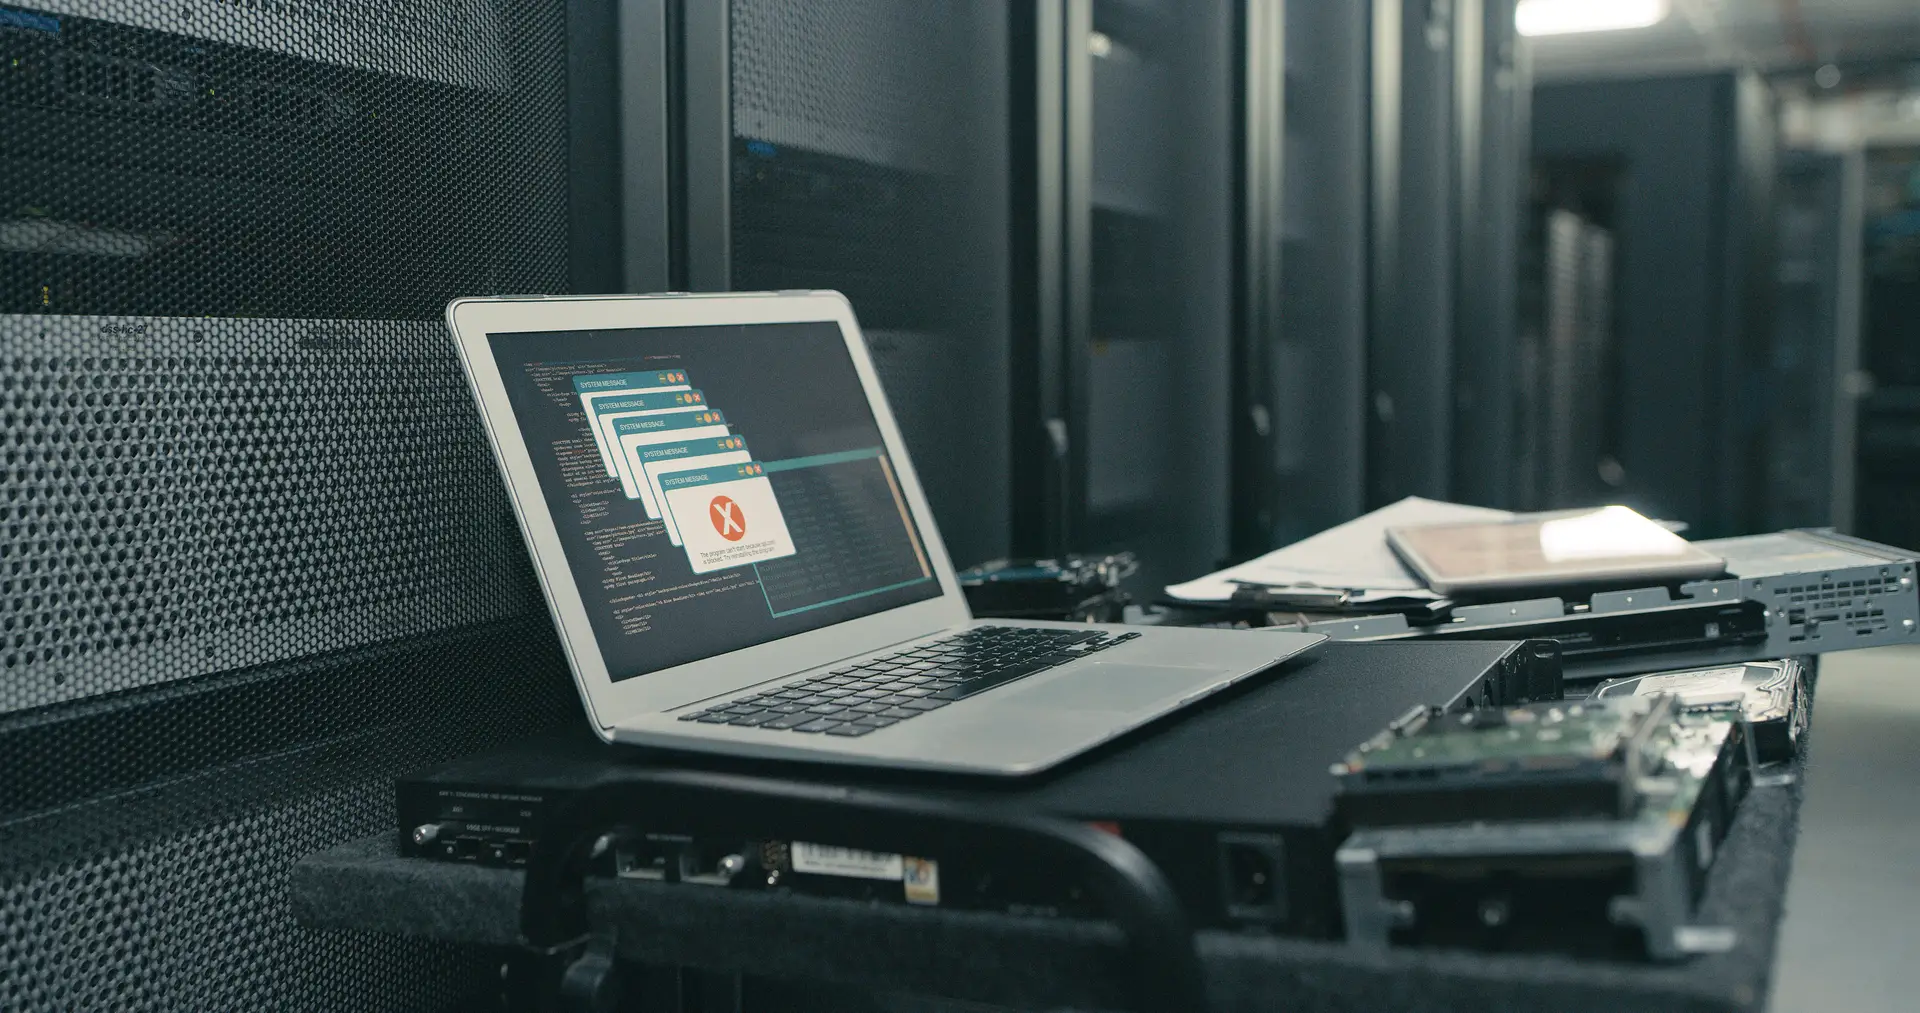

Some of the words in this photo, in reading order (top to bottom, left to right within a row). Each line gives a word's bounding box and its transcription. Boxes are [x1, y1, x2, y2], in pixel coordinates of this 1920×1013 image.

[580, 381, 602, 389] SYSTEM
[602, 379, 628, 387] MESSAGE
[620, 400, 645, 408] MESSAGE
[619, 423, 641, 431] SYSTEM
[641, 420, 666, 429] MESSAGE
[644, 450, 664, 458] SYSTEM
[664, 447, 688, 456] MESSAGE
[664, 477, 685, 486] SYSTEM
[685, 474, 710, 483] MESSAGE
[713, 502, 743, 535] X
[709, 549, 726, 558] program
